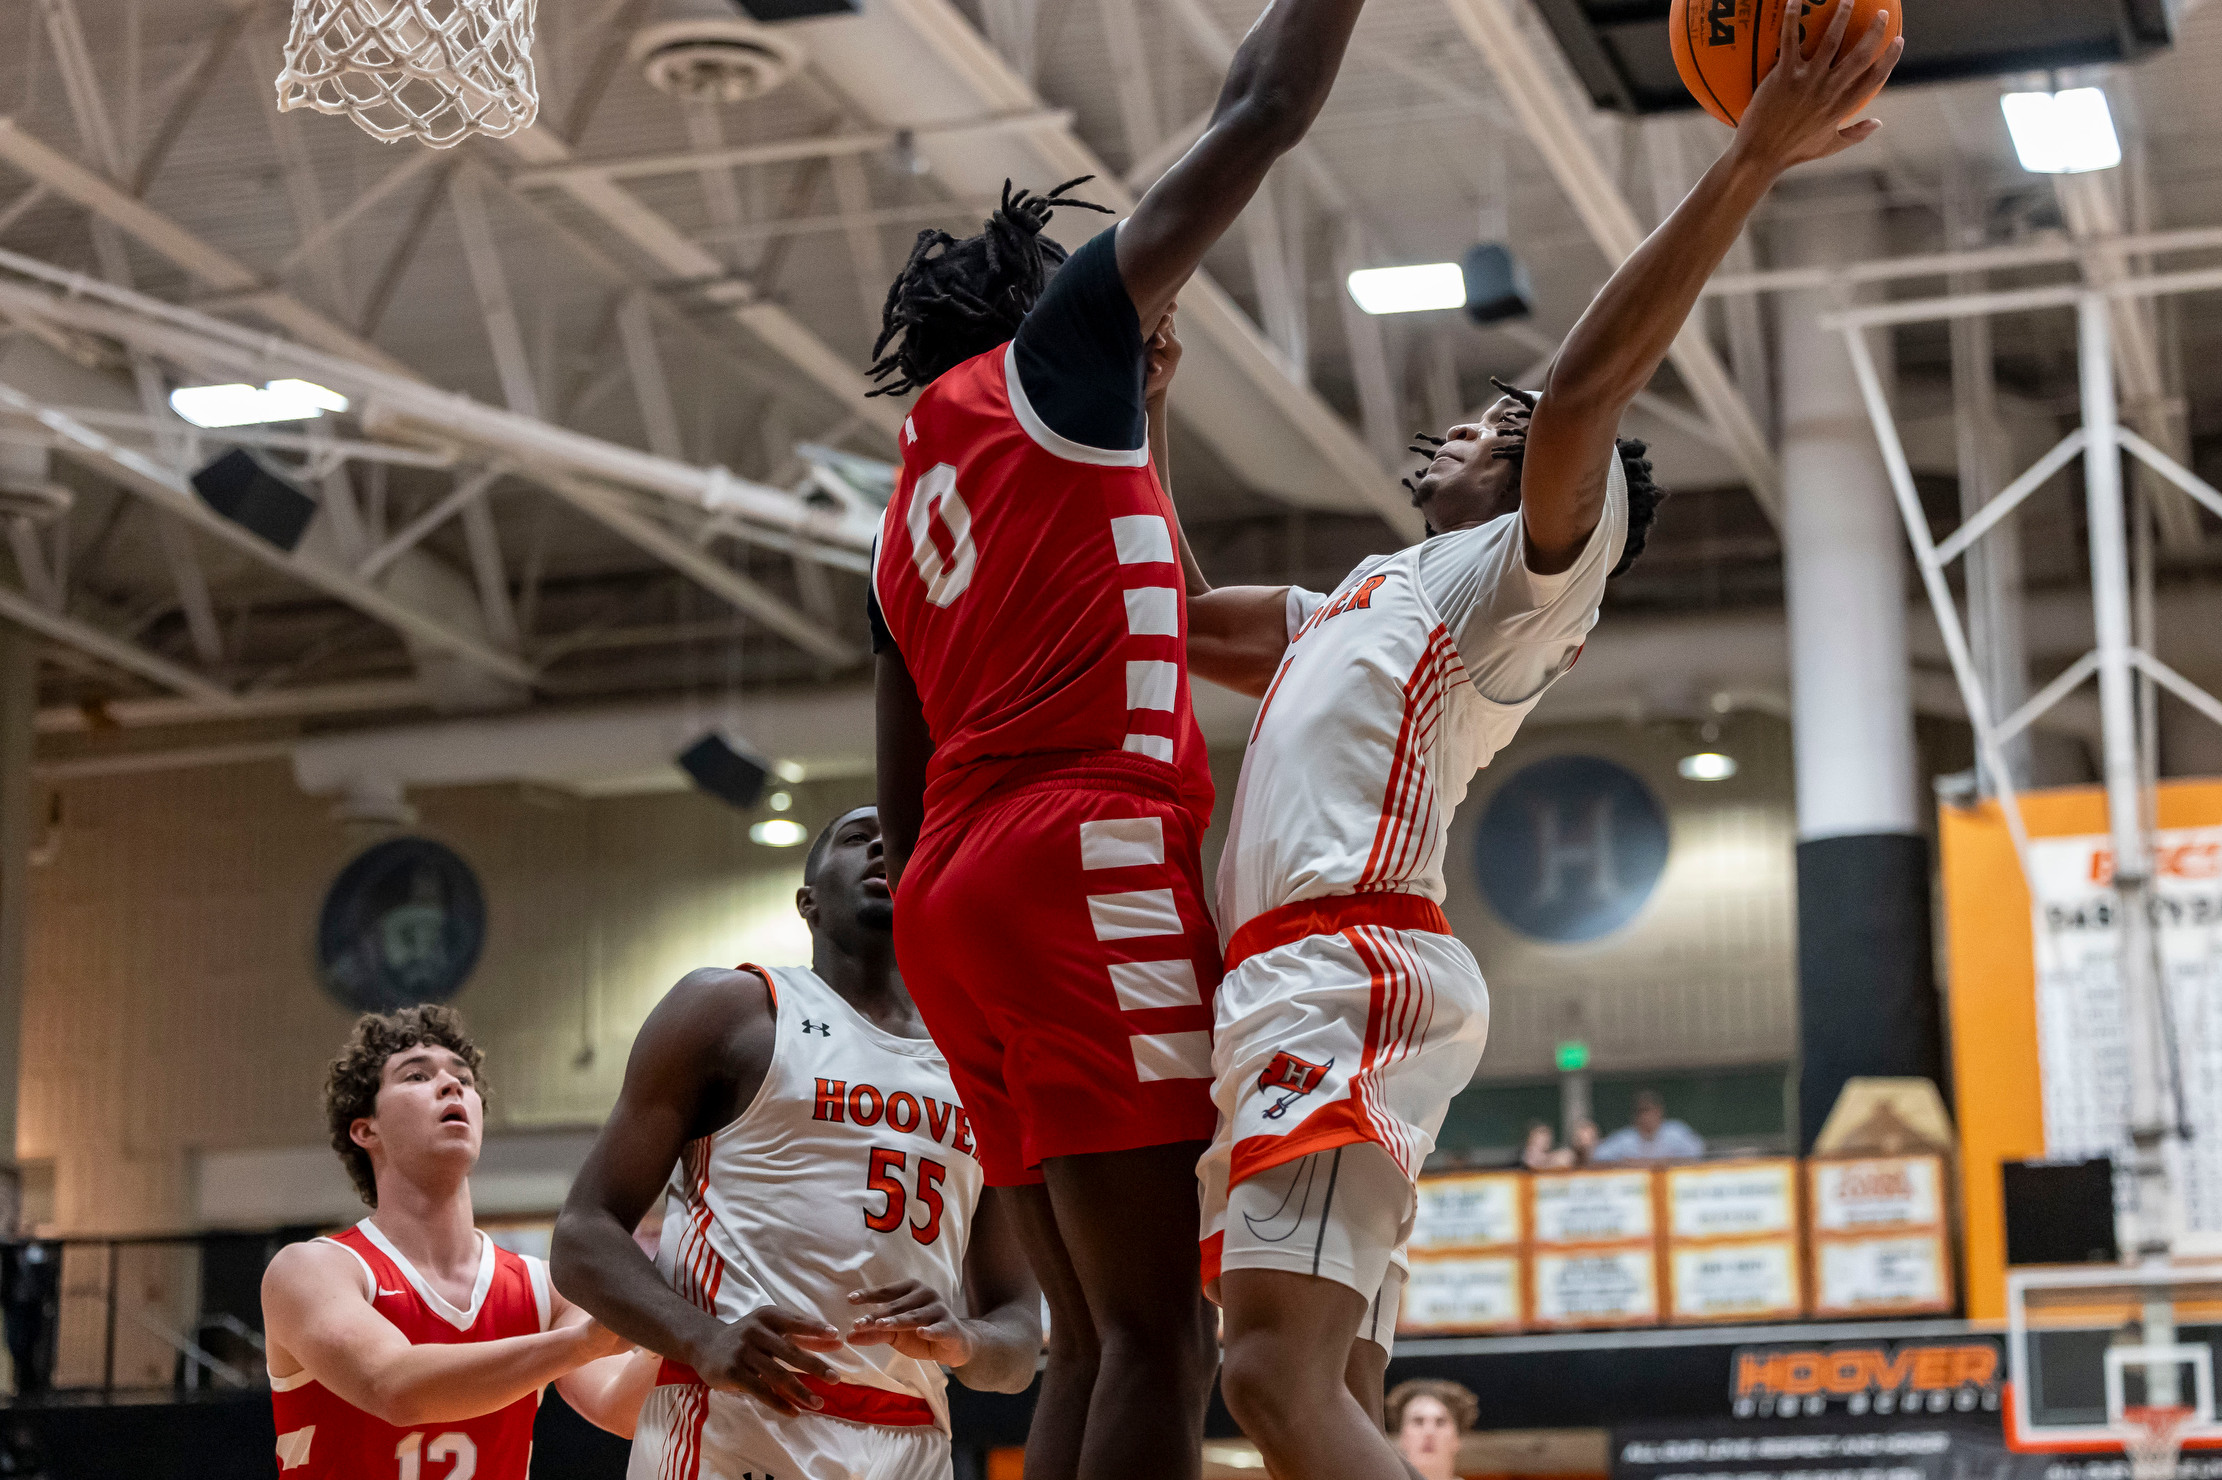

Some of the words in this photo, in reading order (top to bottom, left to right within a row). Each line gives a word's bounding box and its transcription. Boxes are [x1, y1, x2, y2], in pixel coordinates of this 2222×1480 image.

[907, 461, 978, 609] 0
[1281, 1058, 1315, 1089] H
[812, 1077, 984, 1166] HOOVE
[863, 1146, 946, 1245] 55
[1737, 1345, 1998, 1394] HOOVER
[394, 1431, 477, 1480] 12
